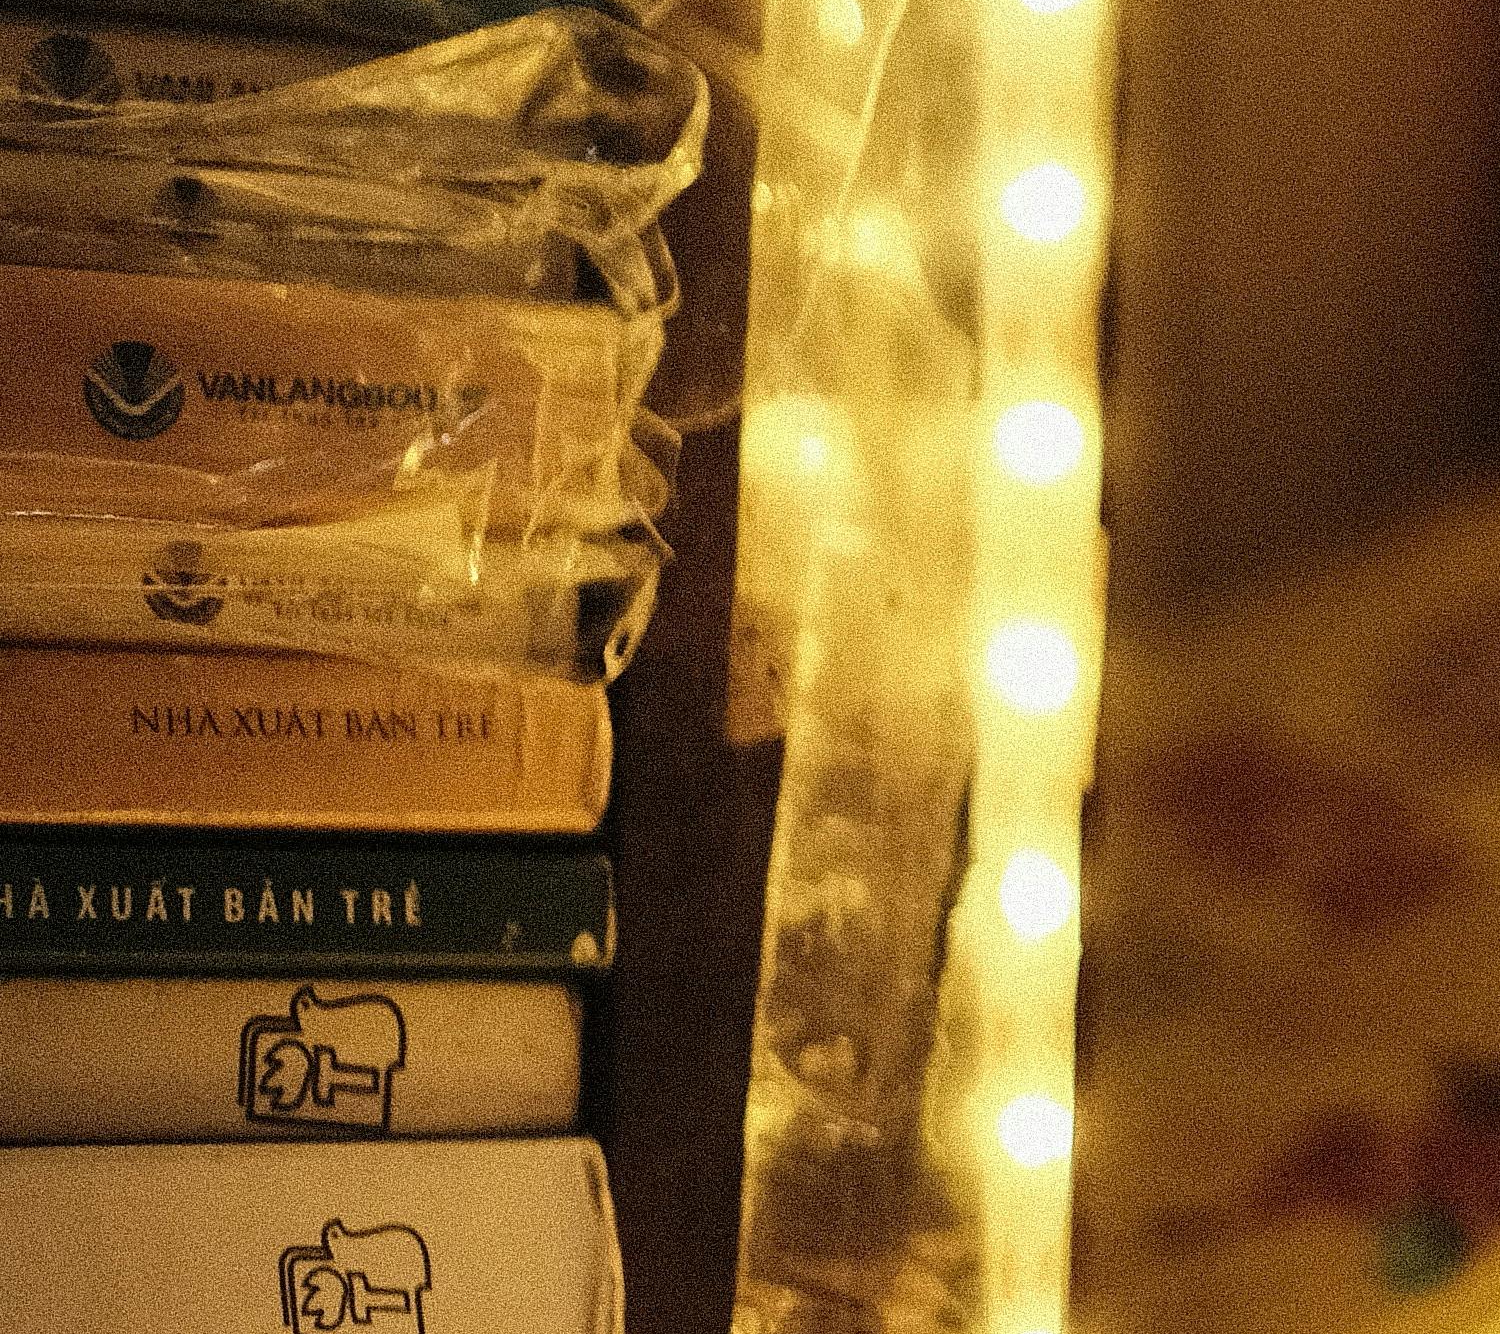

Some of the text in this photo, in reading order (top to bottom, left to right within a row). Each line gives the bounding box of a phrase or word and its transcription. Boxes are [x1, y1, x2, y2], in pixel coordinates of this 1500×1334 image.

[74, 875, 198, 927] XUẤT
[222, 874, 316, 927] BẢN
[338, 876, 422, 928] TRẺ
